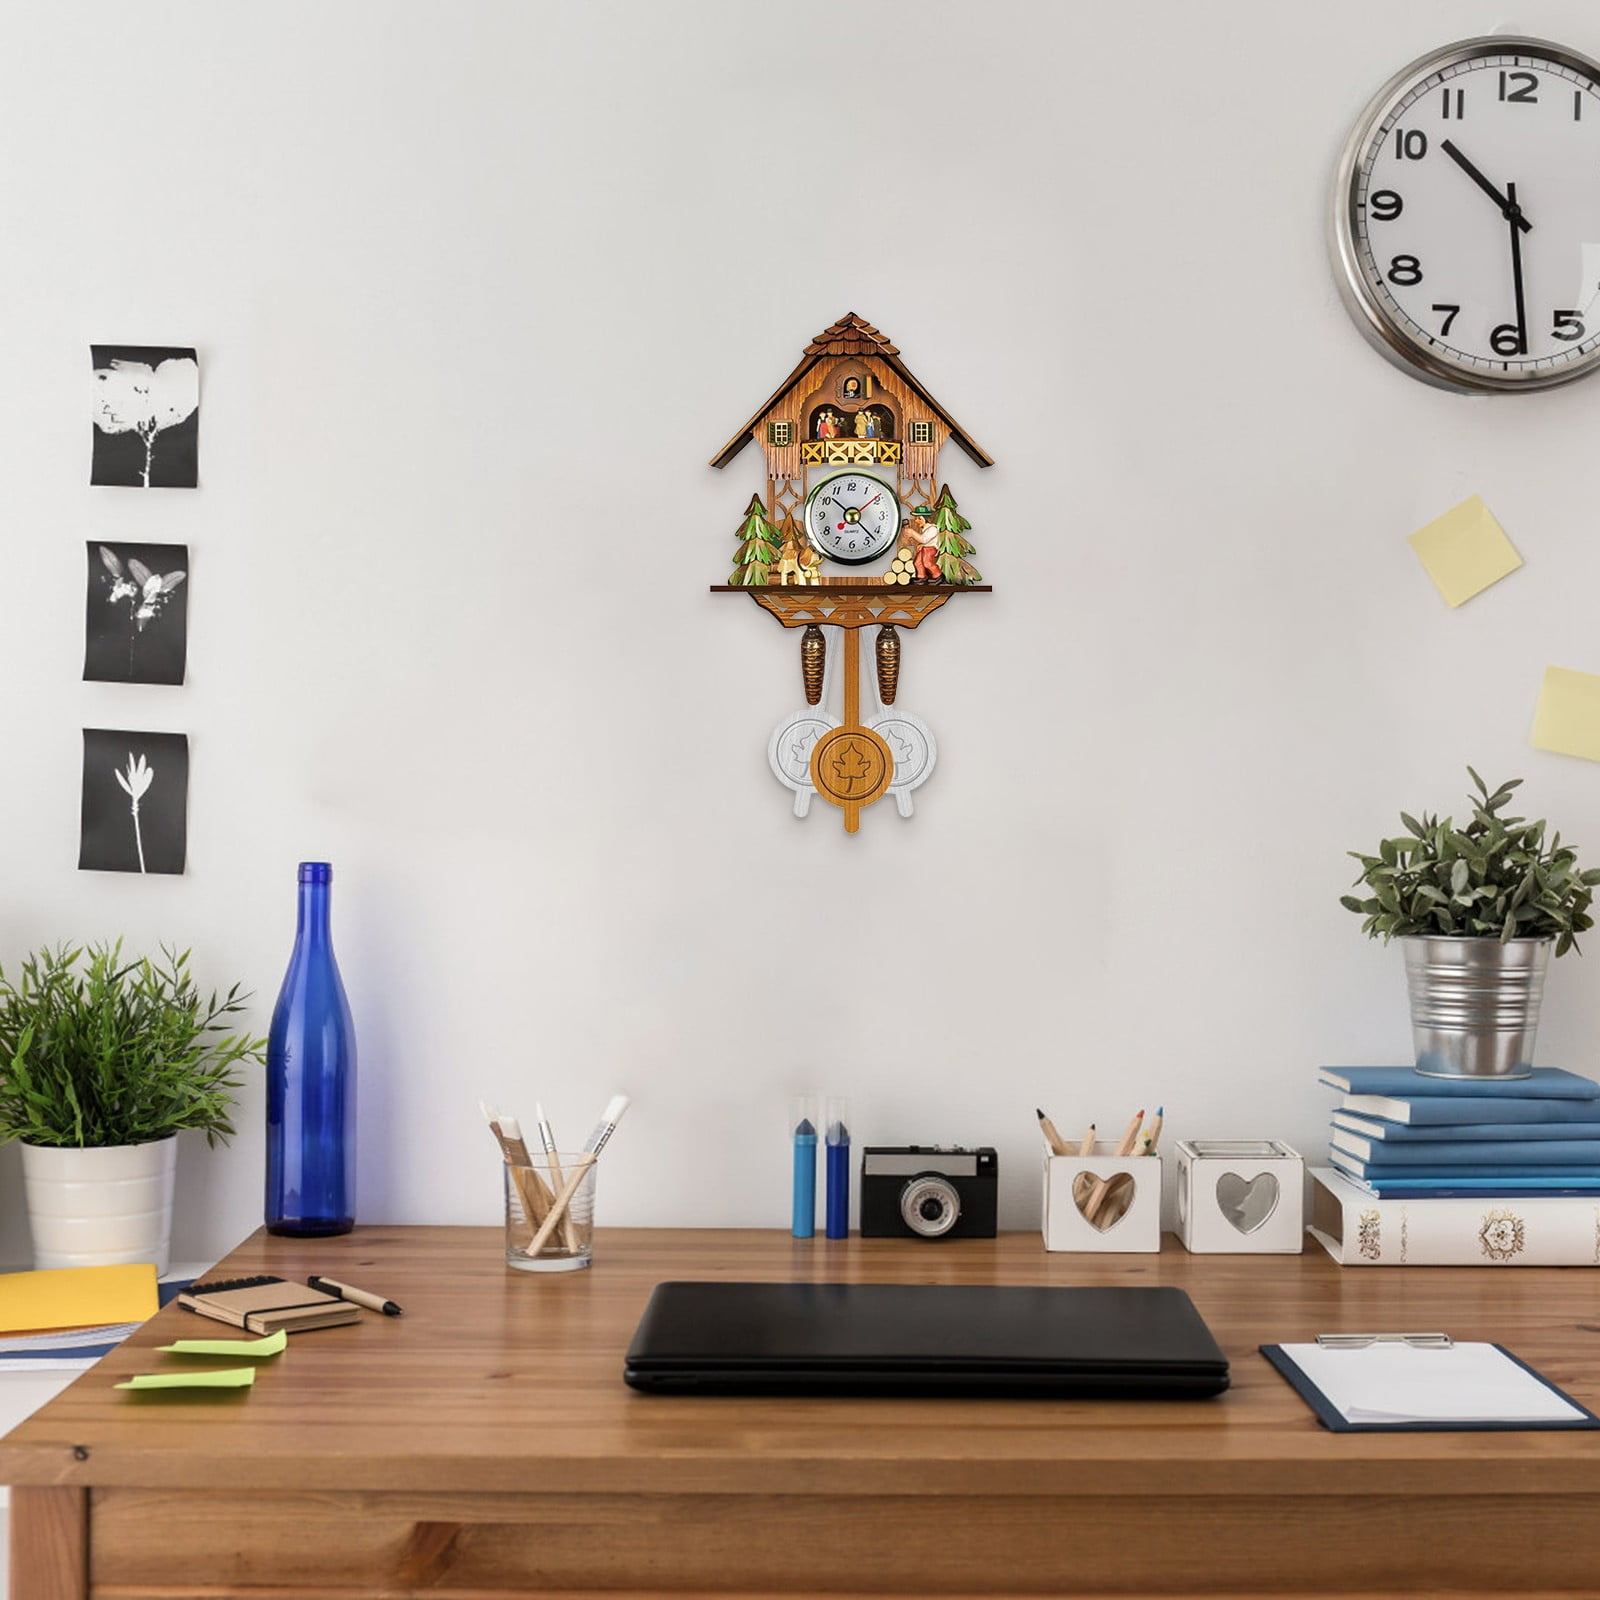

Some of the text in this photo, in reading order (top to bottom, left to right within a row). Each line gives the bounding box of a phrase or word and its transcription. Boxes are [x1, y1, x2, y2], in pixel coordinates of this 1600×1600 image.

[1499, 71, 1539, 104] 12
[1442, 87, 1465, 120] 11
[1574, 90, 1582, 122] 1
[1395, 128, 1428, 161] 10
[1370, 189, 1404, 222] 9
[1387, 254, 1423, 287] 8
[1431, 303, 1461, 336] 7
[1550, 309, 1586, 342] 5
[1489, 323, 1523, 357] 6
[832, 486, 841, 495] 11
[847, 482, 857, 491] 12
[864, 486, 869, 495] 1
[822, 496, 831, 506] 10
[819, 511, 825, 520] 9
[879, 511, 885, 520] 3
[823, 525, 831, 535] 8
[874, 525, 881, 534] 4
[834, 536, 842, 546] 7
[848, 540, 855, 549] 6
[863, 536, 870, 546] 5
